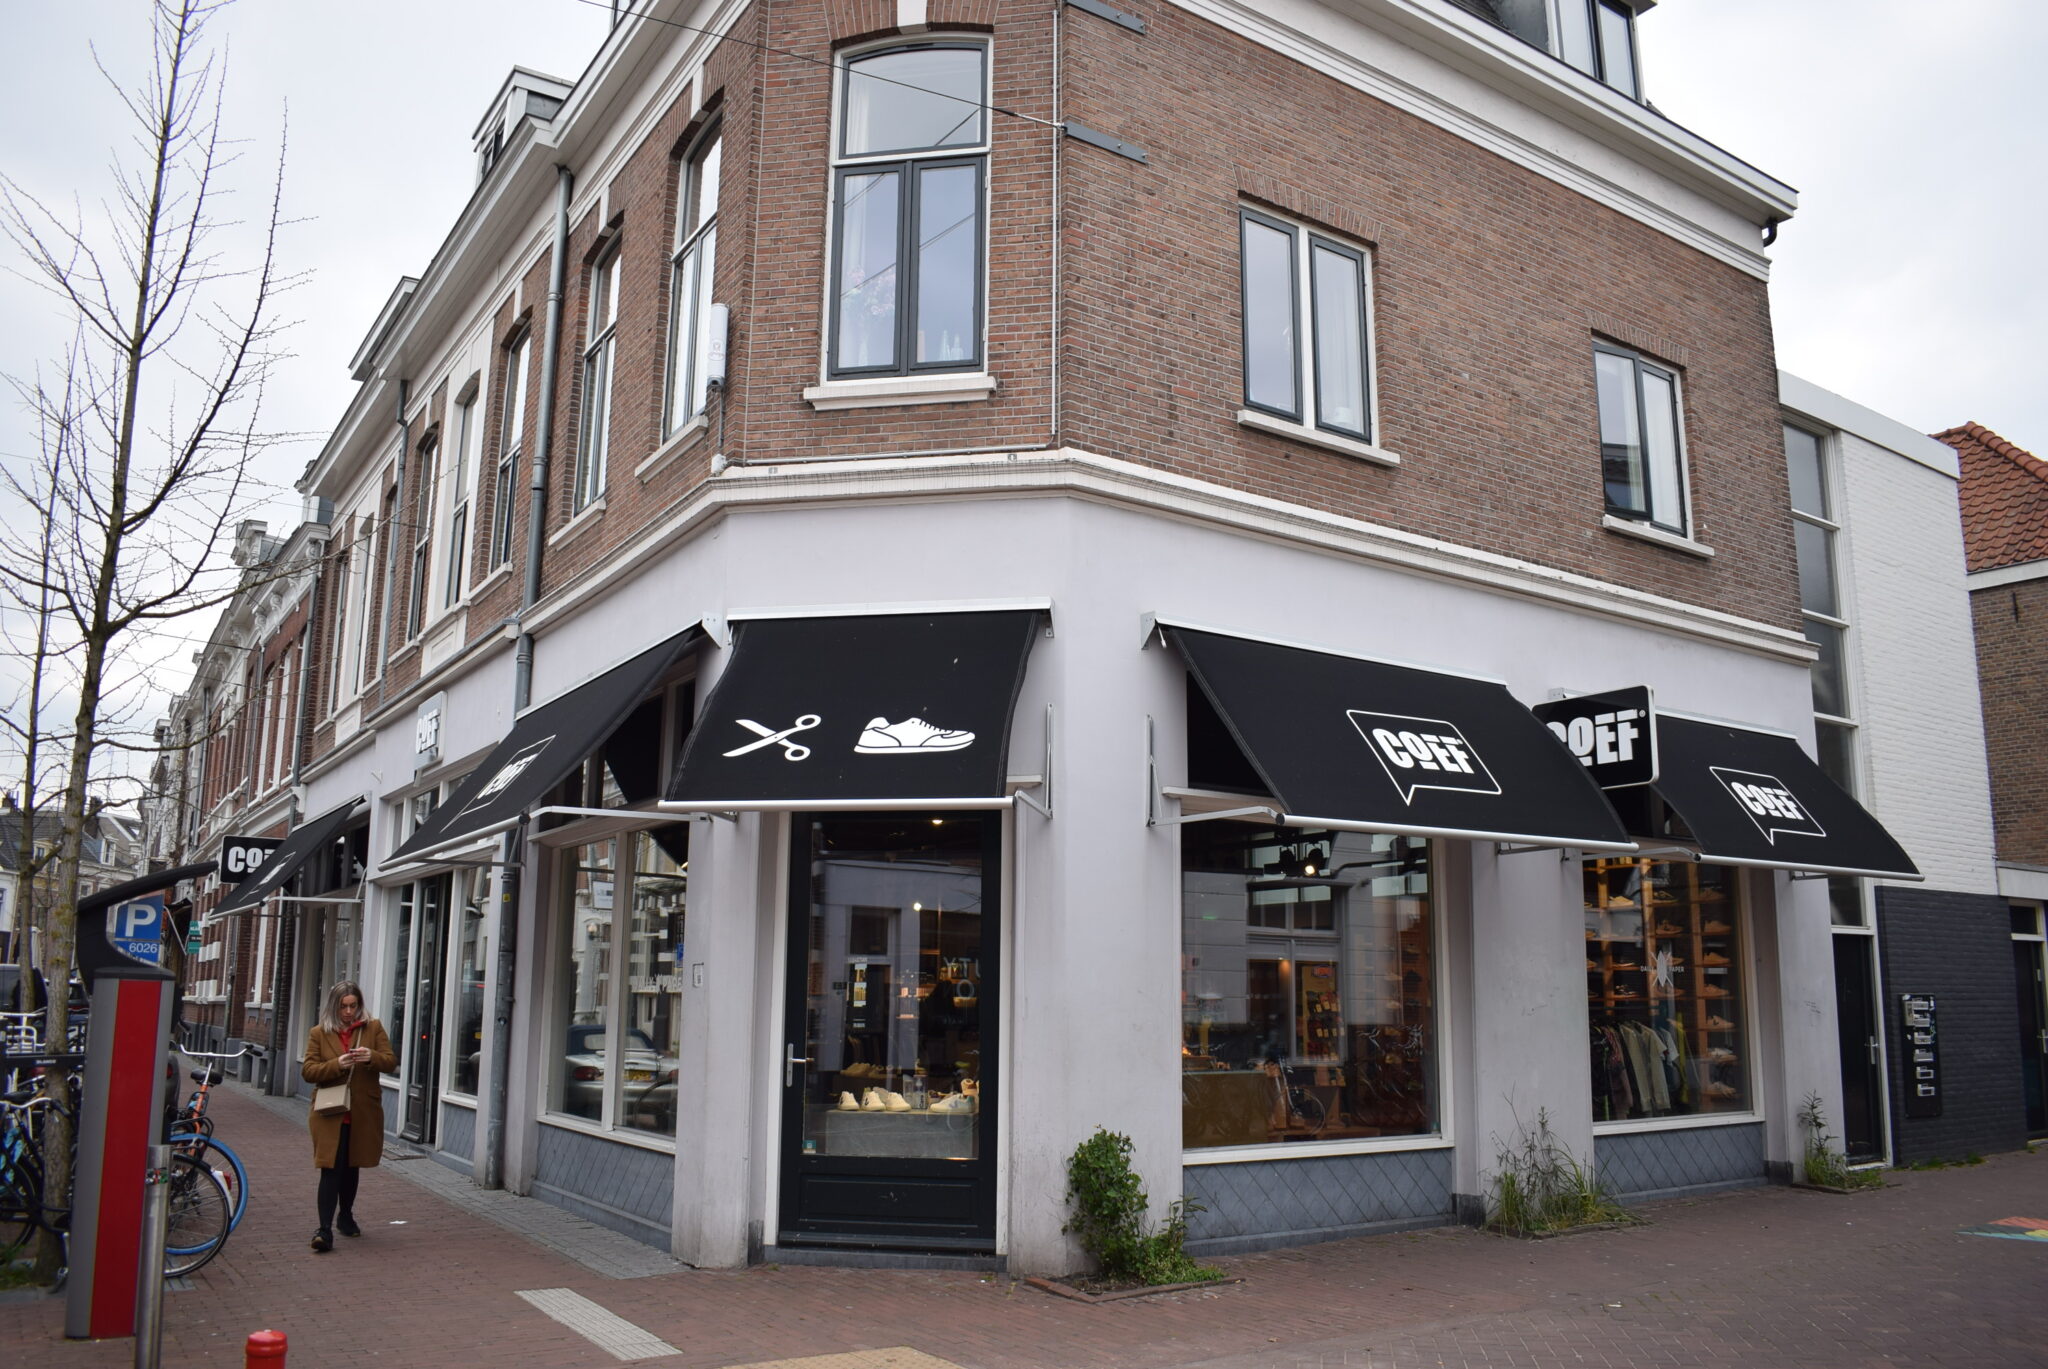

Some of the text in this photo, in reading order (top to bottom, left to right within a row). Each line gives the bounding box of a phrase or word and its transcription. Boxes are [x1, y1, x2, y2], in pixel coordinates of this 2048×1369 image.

[1372, 728, 1475, 774] COEF
[1730, 782, 1805, 820] COEF
[227, 846, 276, 873] CO
[125, 903, 156, 937] P
[129, 942, 158, 954] 6026
